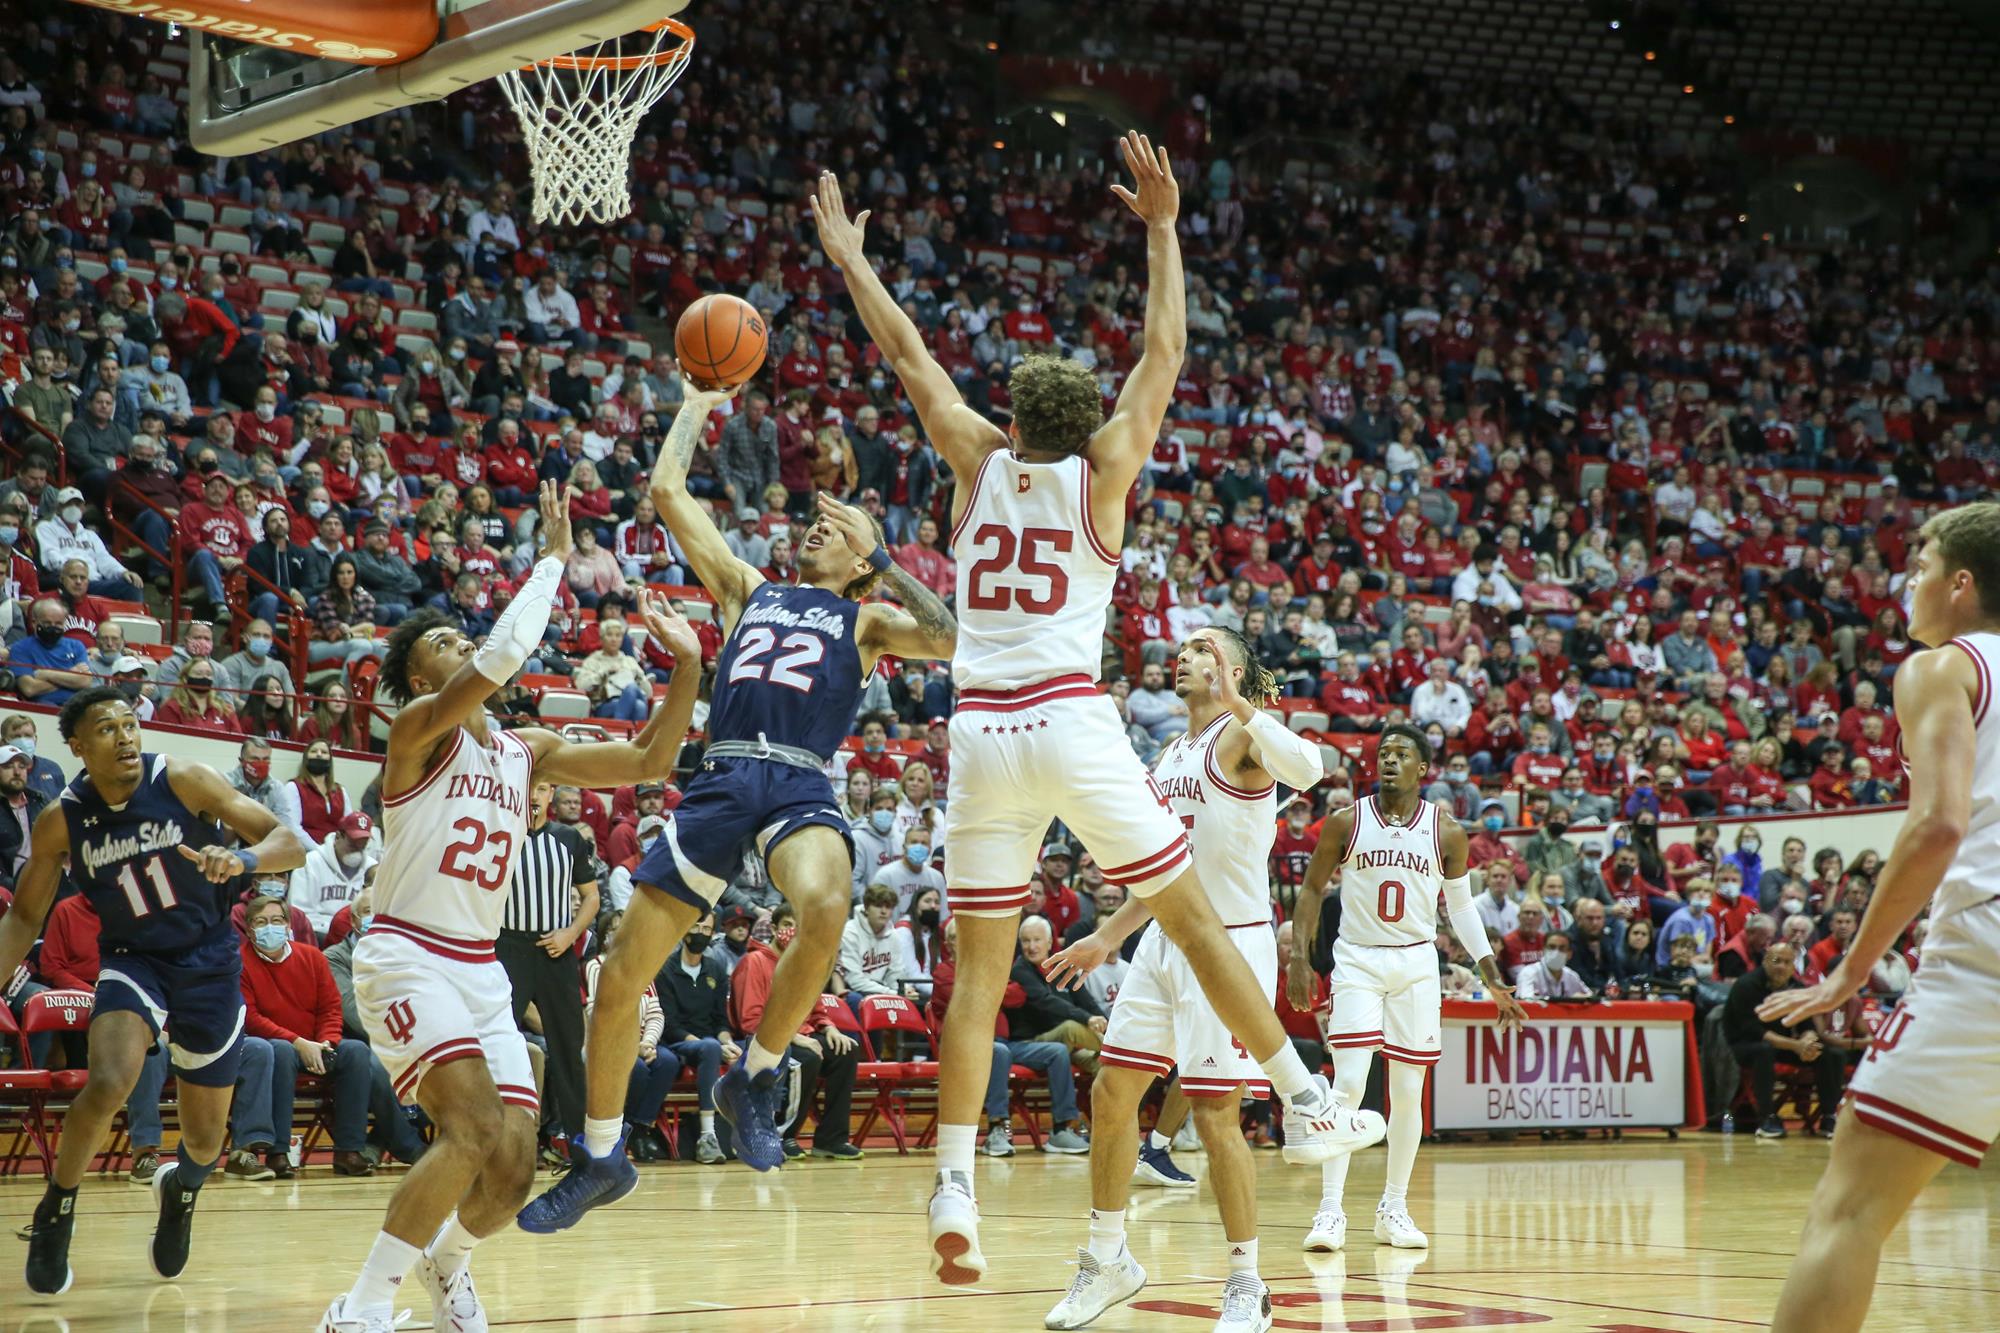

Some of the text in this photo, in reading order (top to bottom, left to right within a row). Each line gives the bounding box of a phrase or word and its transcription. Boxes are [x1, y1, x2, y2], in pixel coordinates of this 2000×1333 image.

[151, 9, 314, 48] State
[968, 523, 1074, 616] 25
[798, 608, 845, 640] State
[728, 626, 825, 696] 22
[82, 819, 184, 879] Jackson State
[438, 816, 512, 892] 23
[1356, 850, 1430, 877] INDIANA
[115, 854, 179, 918] 11
[1377, 880, 1406, 923] 0
[43, 995, 93, 1008] INDIANA
[1465, 1026, 1654, 1084] INDIANA
[1487, 1087, 1633, 1120] BASKETBALL
